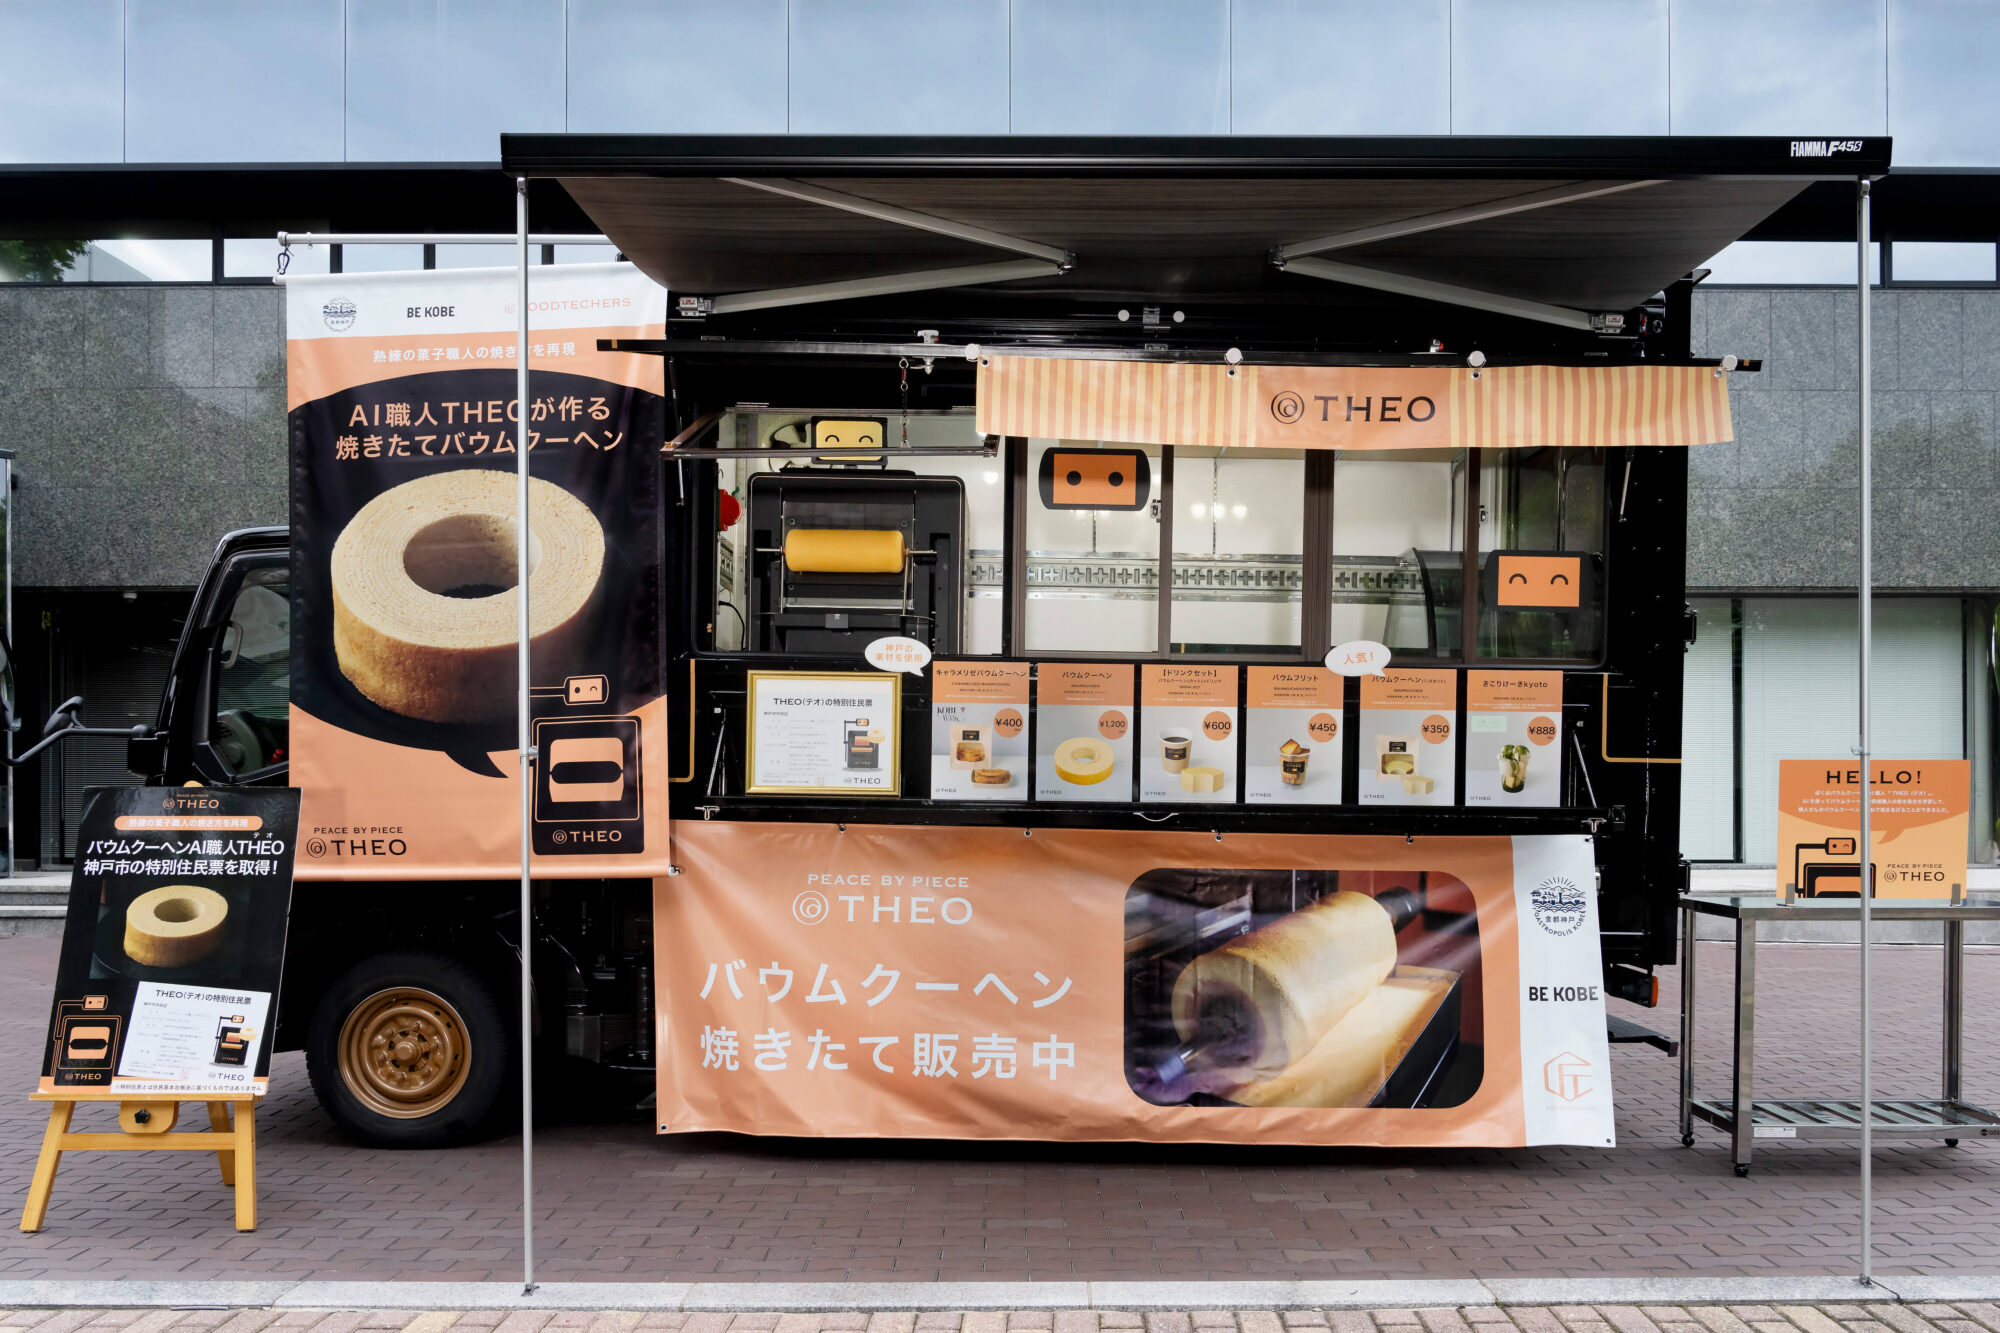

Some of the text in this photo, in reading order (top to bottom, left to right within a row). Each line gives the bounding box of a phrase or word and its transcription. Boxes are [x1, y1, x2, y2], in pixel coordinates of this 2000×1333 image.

[1790, 141, 1827, 157] FIAMMA
[527, 298, 632, 312] OODTECHERS
[406, 306, 456, 319] BE KOBE
[373, 342, 576, 365] 熟練の菓子職人の焼きを再現
[1314, 395, 1436, 422] THEO
[885, 643, 913, 652] 神戸の
[876, 652, 923, 662] 素材を使用
[1344, 651, 1374, 664] 人気！
[936, 669, 1027, 677] キャラメリゼバウムクーヘン
[1162, 669, 1216, 677] 【ドリンクセット】
[1272, 674, 1319, 682] バウムフリット
[1482, 680, 1548, 688] きこりけーきkyoto
[996, 718, 1022, 727] ¥400
[1100, 720, 1126, 728] ¥1,200
[1204, 721, 1231, 730] ¥600
[1309, 723, 1336, 732] ¥450
[1423, 724, 1450, 733] ¥350
[1529, 726, 1555, 734] ¥888
[1826, 770, 1920, 784] HELO!
[177, 799, 219, 808] THEO
[314, 827, 351, 835] PEACE
[570, 830, 622, 842] THEO
[86, 839, 285, 856] バウムクーヘンAI職人THEO
[331, 838, 407, 857] THEO
[84, 859, 278, 876] 神戸市の特別住民票を取得！
[808, 874, 969, 888] PEACE BY PIECE
[1900, 872, 1945, 882] THEO
[838, 895, 973, 924] THEO
[700, 959, 1073, 1009] バウムクーヘン
[1528, 986, 1598, 1002] BE KOBE
[700, 1025, 1076, 1080] 焼きたて販売中
[217, 1072, 244, 1081] THEO
